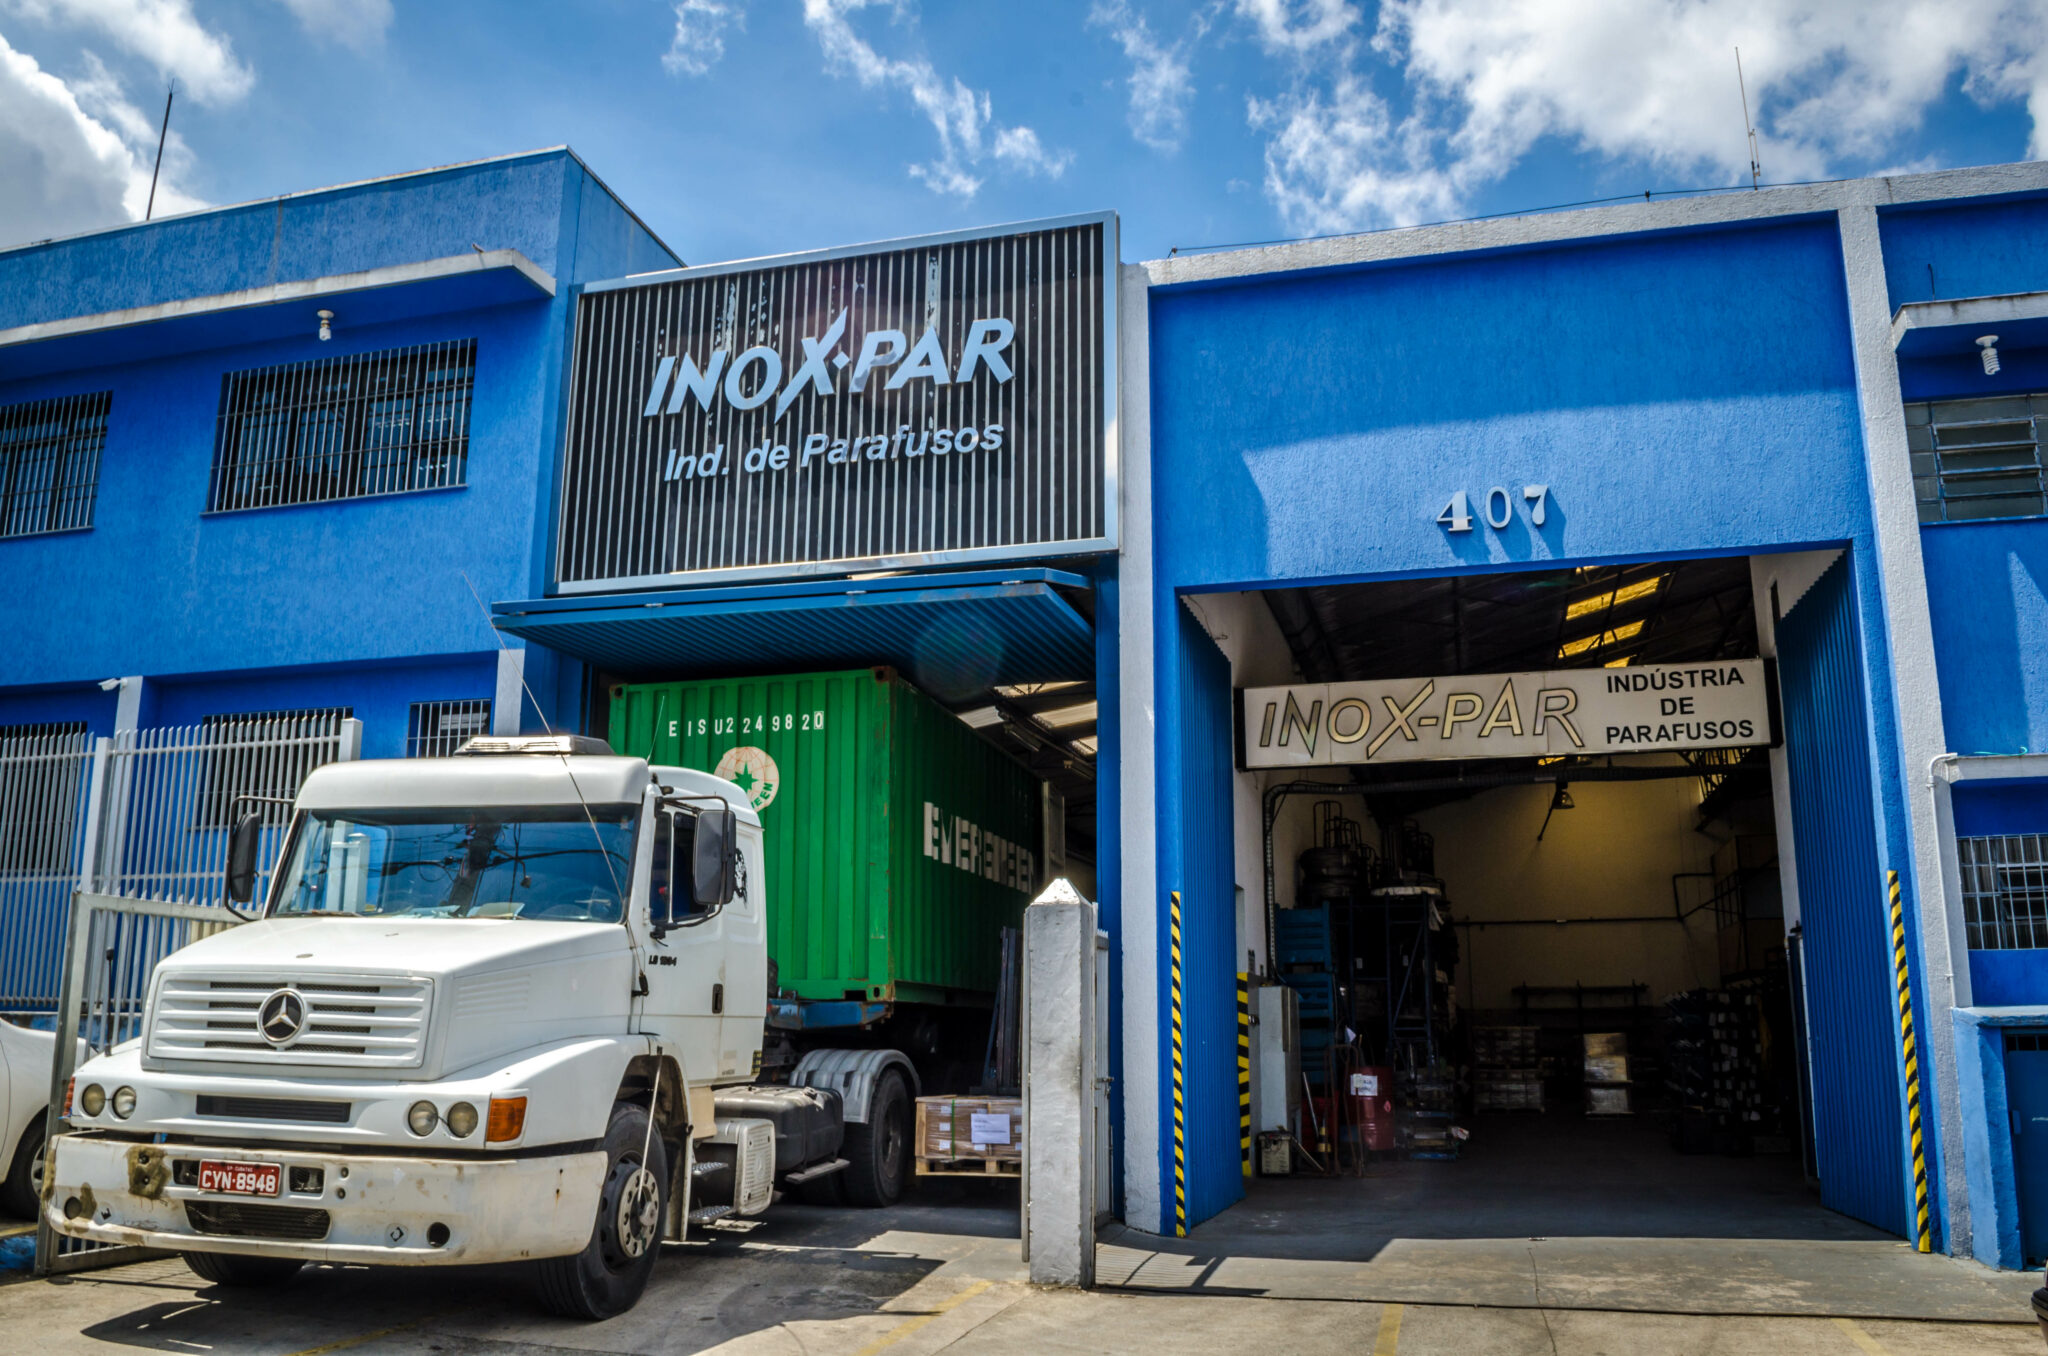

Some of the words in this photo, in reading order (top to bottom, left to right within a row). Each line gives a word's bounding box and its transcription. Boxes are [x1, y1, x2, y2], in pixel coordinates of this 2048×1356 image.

[664, 444, 729, 482] Ind.
[744, 434, 789, 473] de
[800, 422, 1004, 468] Parafusos
[1436, 484, 1548, 532] 407
[1606, 666, 1745, 694] INDÚSTRIA
[1259, 677, 1585, 760] INOX-PAR
[1659, 696, 1696, 717] DE
[1605, 719, 1754, 745] PARAFUSOS
